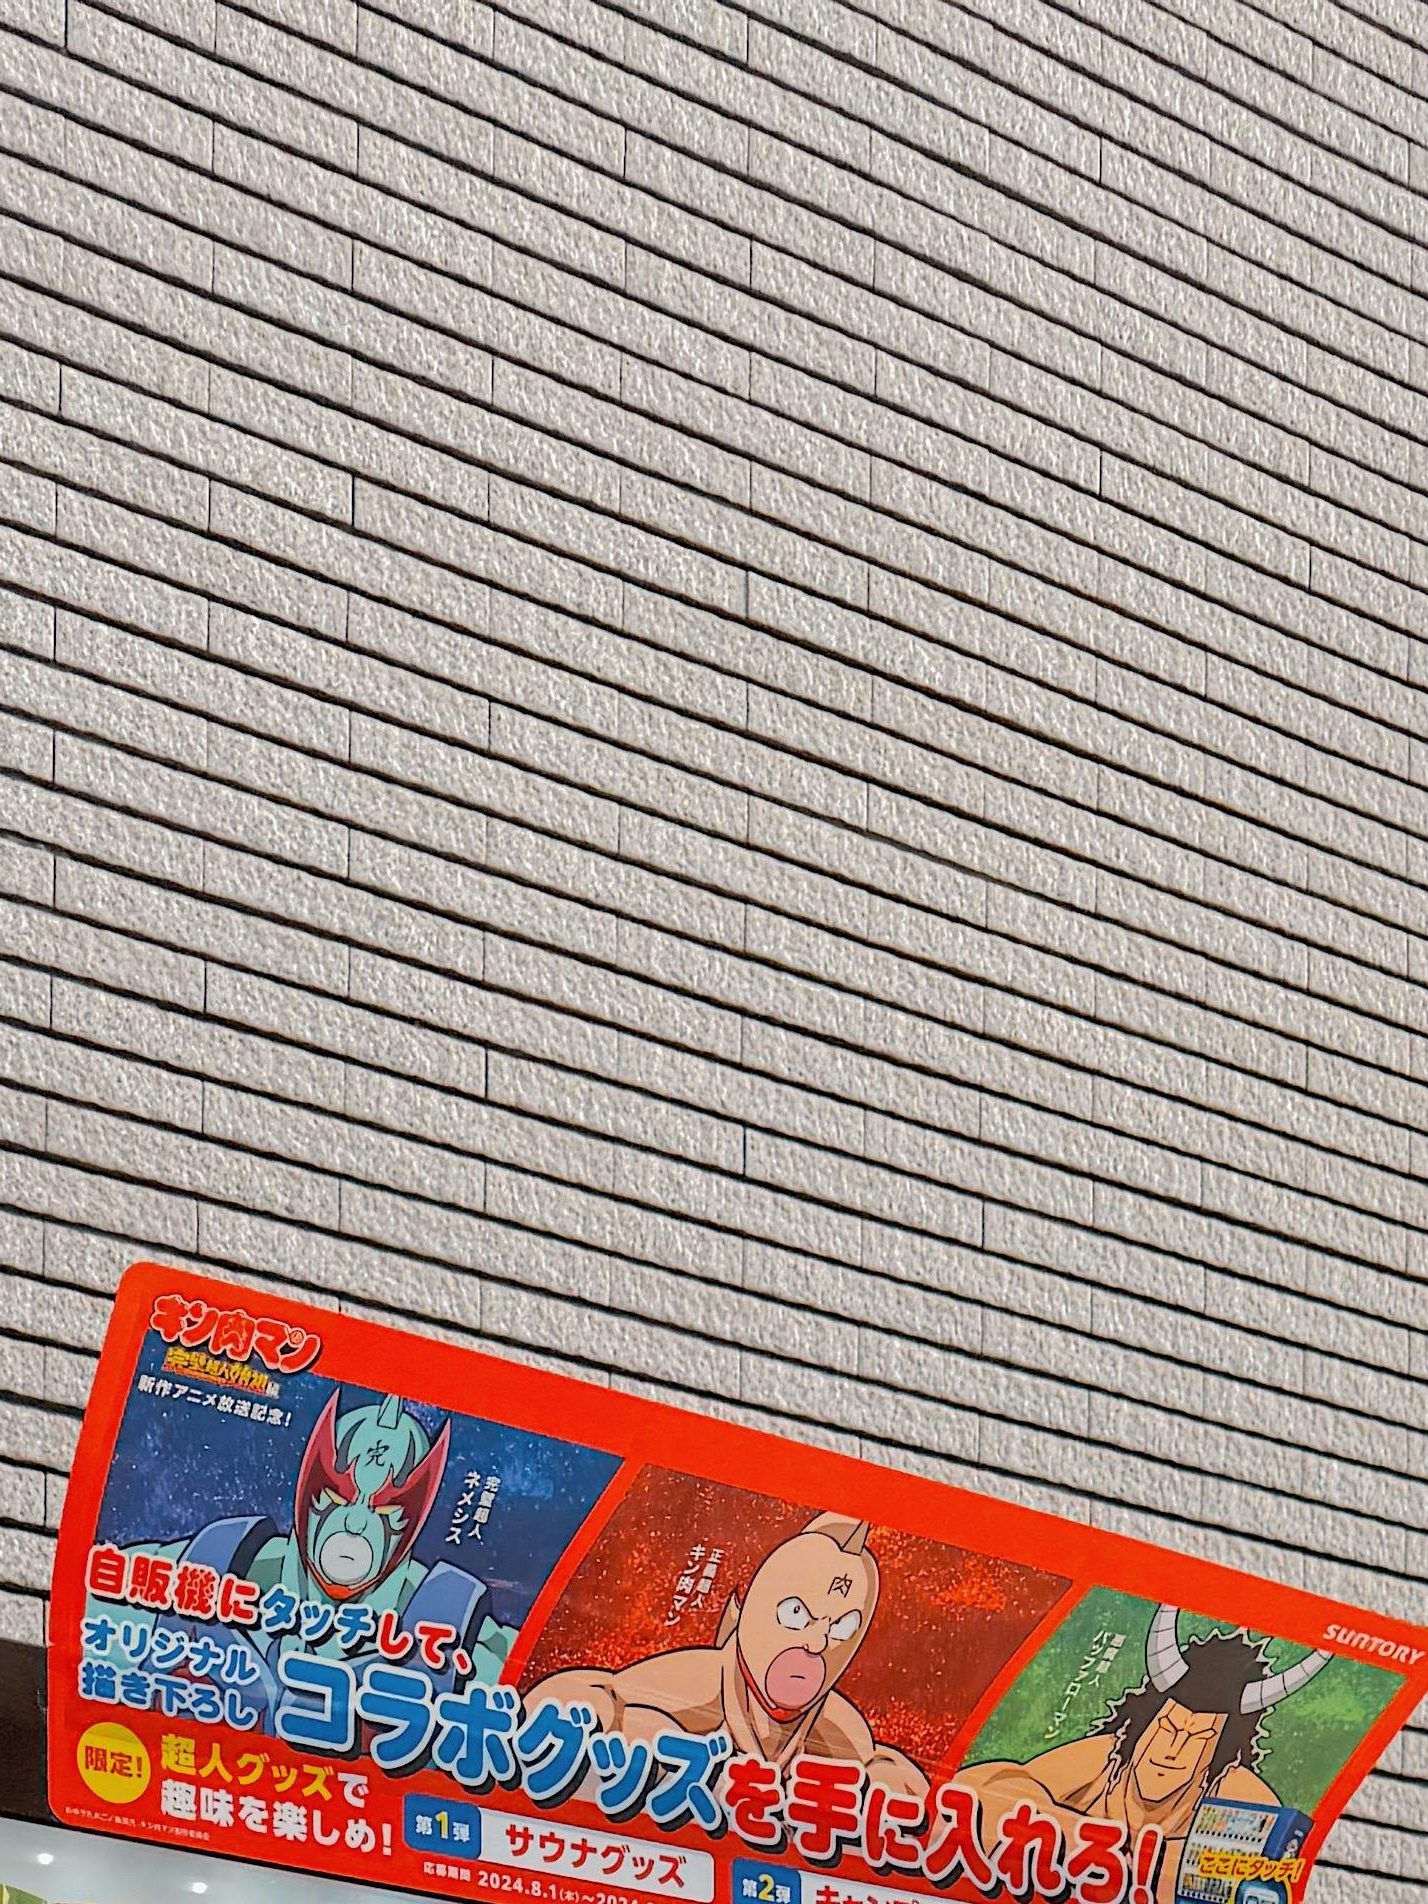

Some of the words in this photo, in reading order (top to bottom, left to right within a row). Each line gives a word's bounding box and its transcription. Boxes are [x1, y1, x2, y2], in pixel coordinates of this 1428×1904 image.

[445, 1471, 481, 1545] ネメシス
[86, 1545, 473, 1674] 自販機にタッチして、
[827, 1575, 852, 1598] 肉
[83, 1618, 260, 1685] オリジナル
[1324, 1623, 1425, 1667] SUNTORY
[81, 1663, 260, 1729] 描き下ろし
[84, 1745, 143, 1778] 限定!
[161, 1733, 371, 1805] 超人グッズで
[161, 1780, 394, 1854] 趣味を楽しめ!
[415, 1811, 472, 1844] 第1弾
[504, 1825, 687, 1887] サウナグッズ
[1198, 1855, 1306, 1882] ここにタッチ!
[741, 1876, 791, 1904] 第2弾
